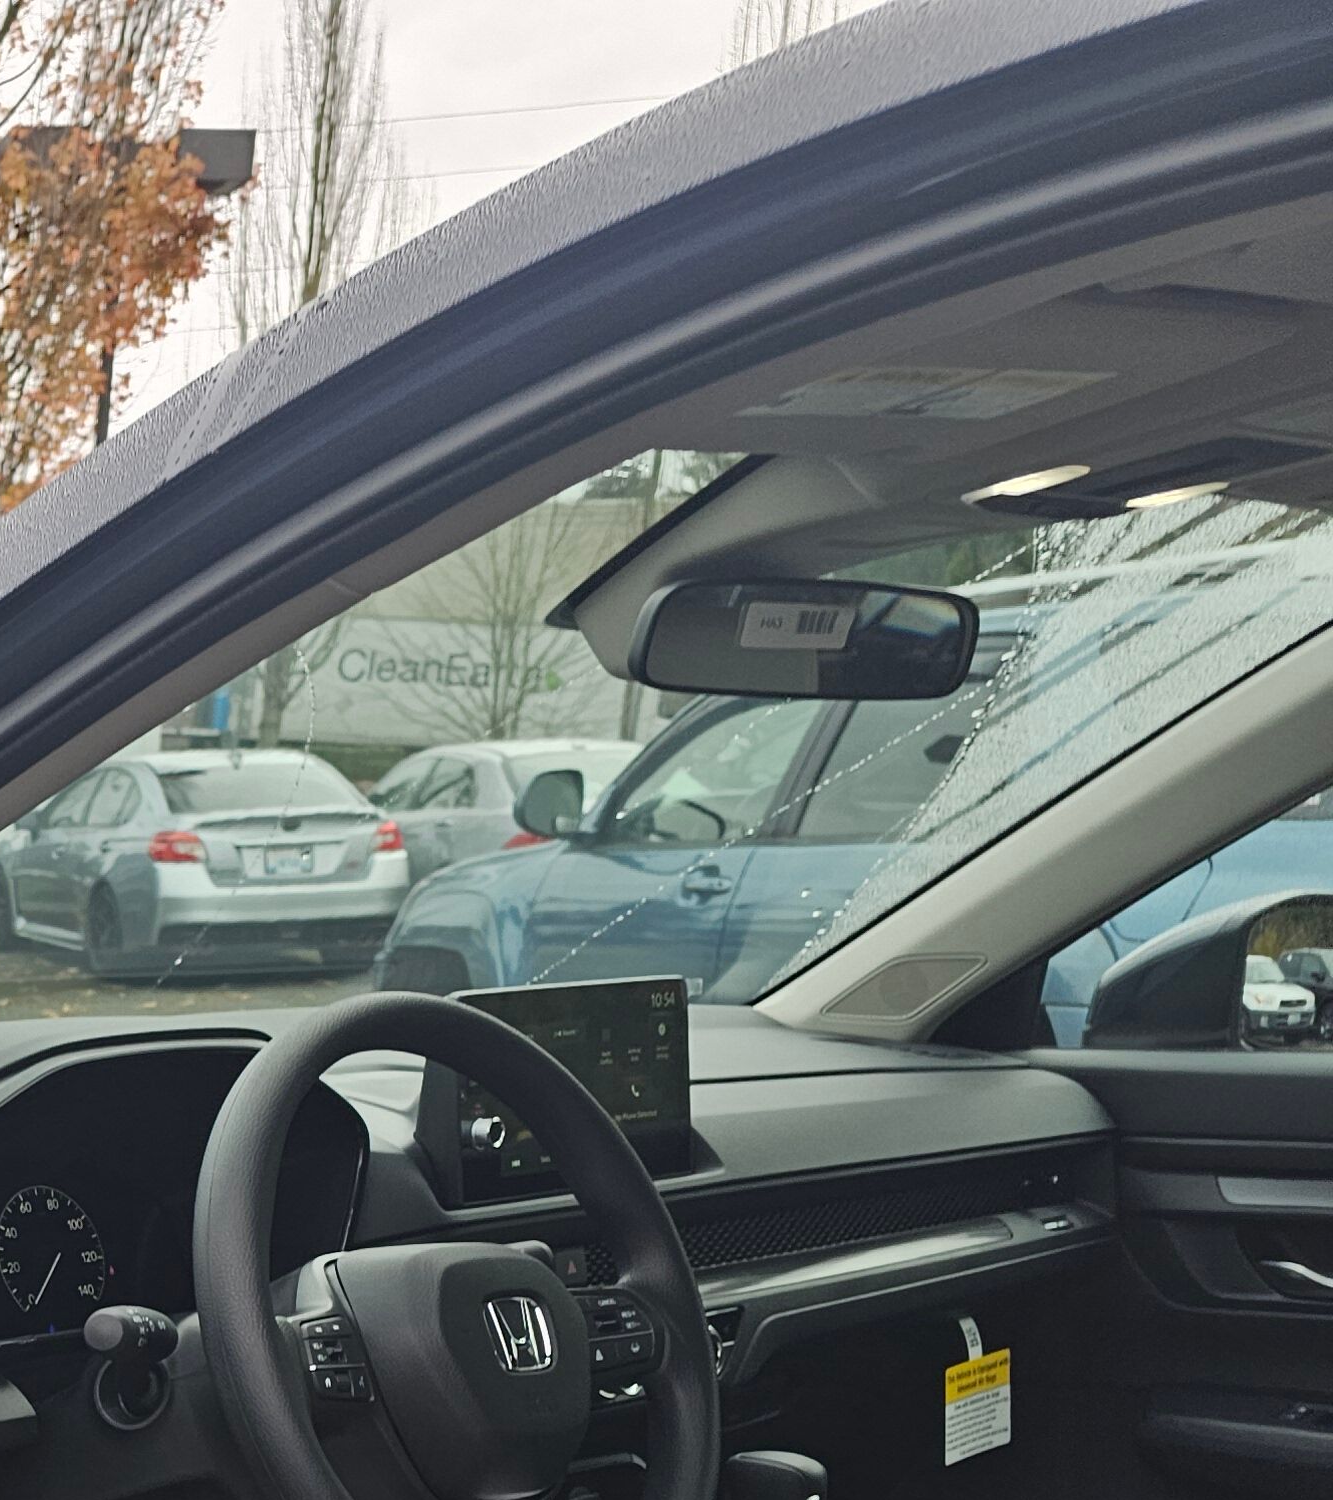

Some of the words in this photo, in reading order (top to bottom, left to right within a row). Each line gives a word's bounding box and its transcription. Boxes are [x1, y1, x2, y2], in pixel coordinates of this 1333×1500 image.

[19, 1201, 33, 1214] 60
[46, 1198, 60, 1211] 80
[66, 1218, 84, 1231] 100
[4, 1227, 18, 1240] 40
[80, 1250, 98, 1263] 120
[7, 1261, 22, 1274] 20
[77, 1283, 96, 1297] 140
